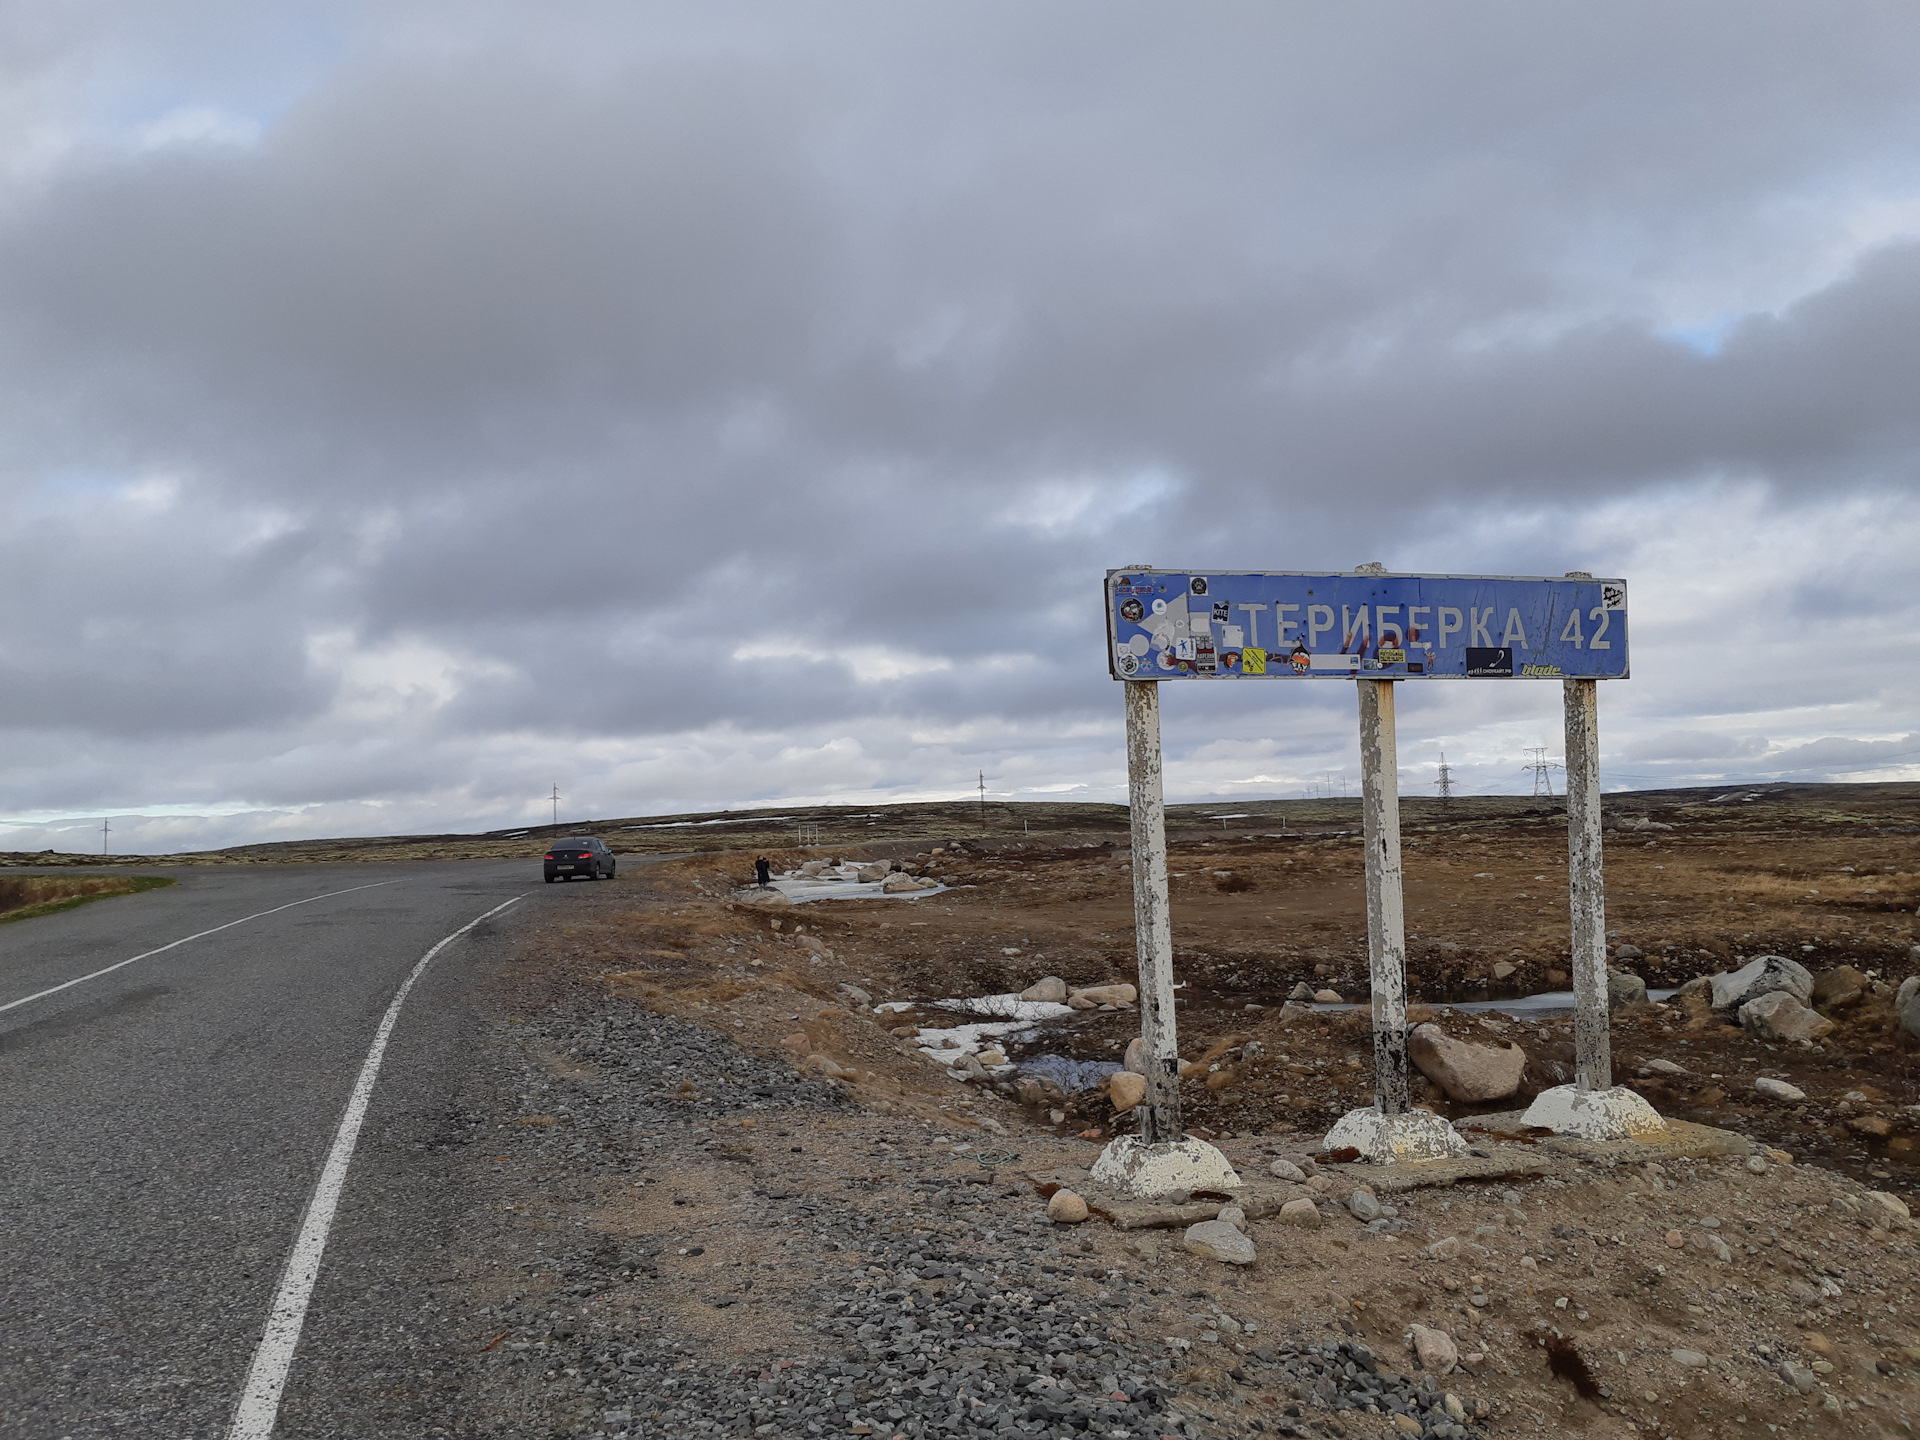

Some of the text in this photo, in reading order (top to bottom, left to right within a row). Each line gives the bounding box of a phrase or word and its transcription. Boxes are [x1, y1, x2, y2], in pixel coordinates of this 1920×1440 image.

[1213, 608, 1228, 618] KITE
[1238, 603, 1529, 649] ТЕРИБЕРКА
[1560, 607, 1611, 650] 42
[1521, 664, 1564, 676] blade
